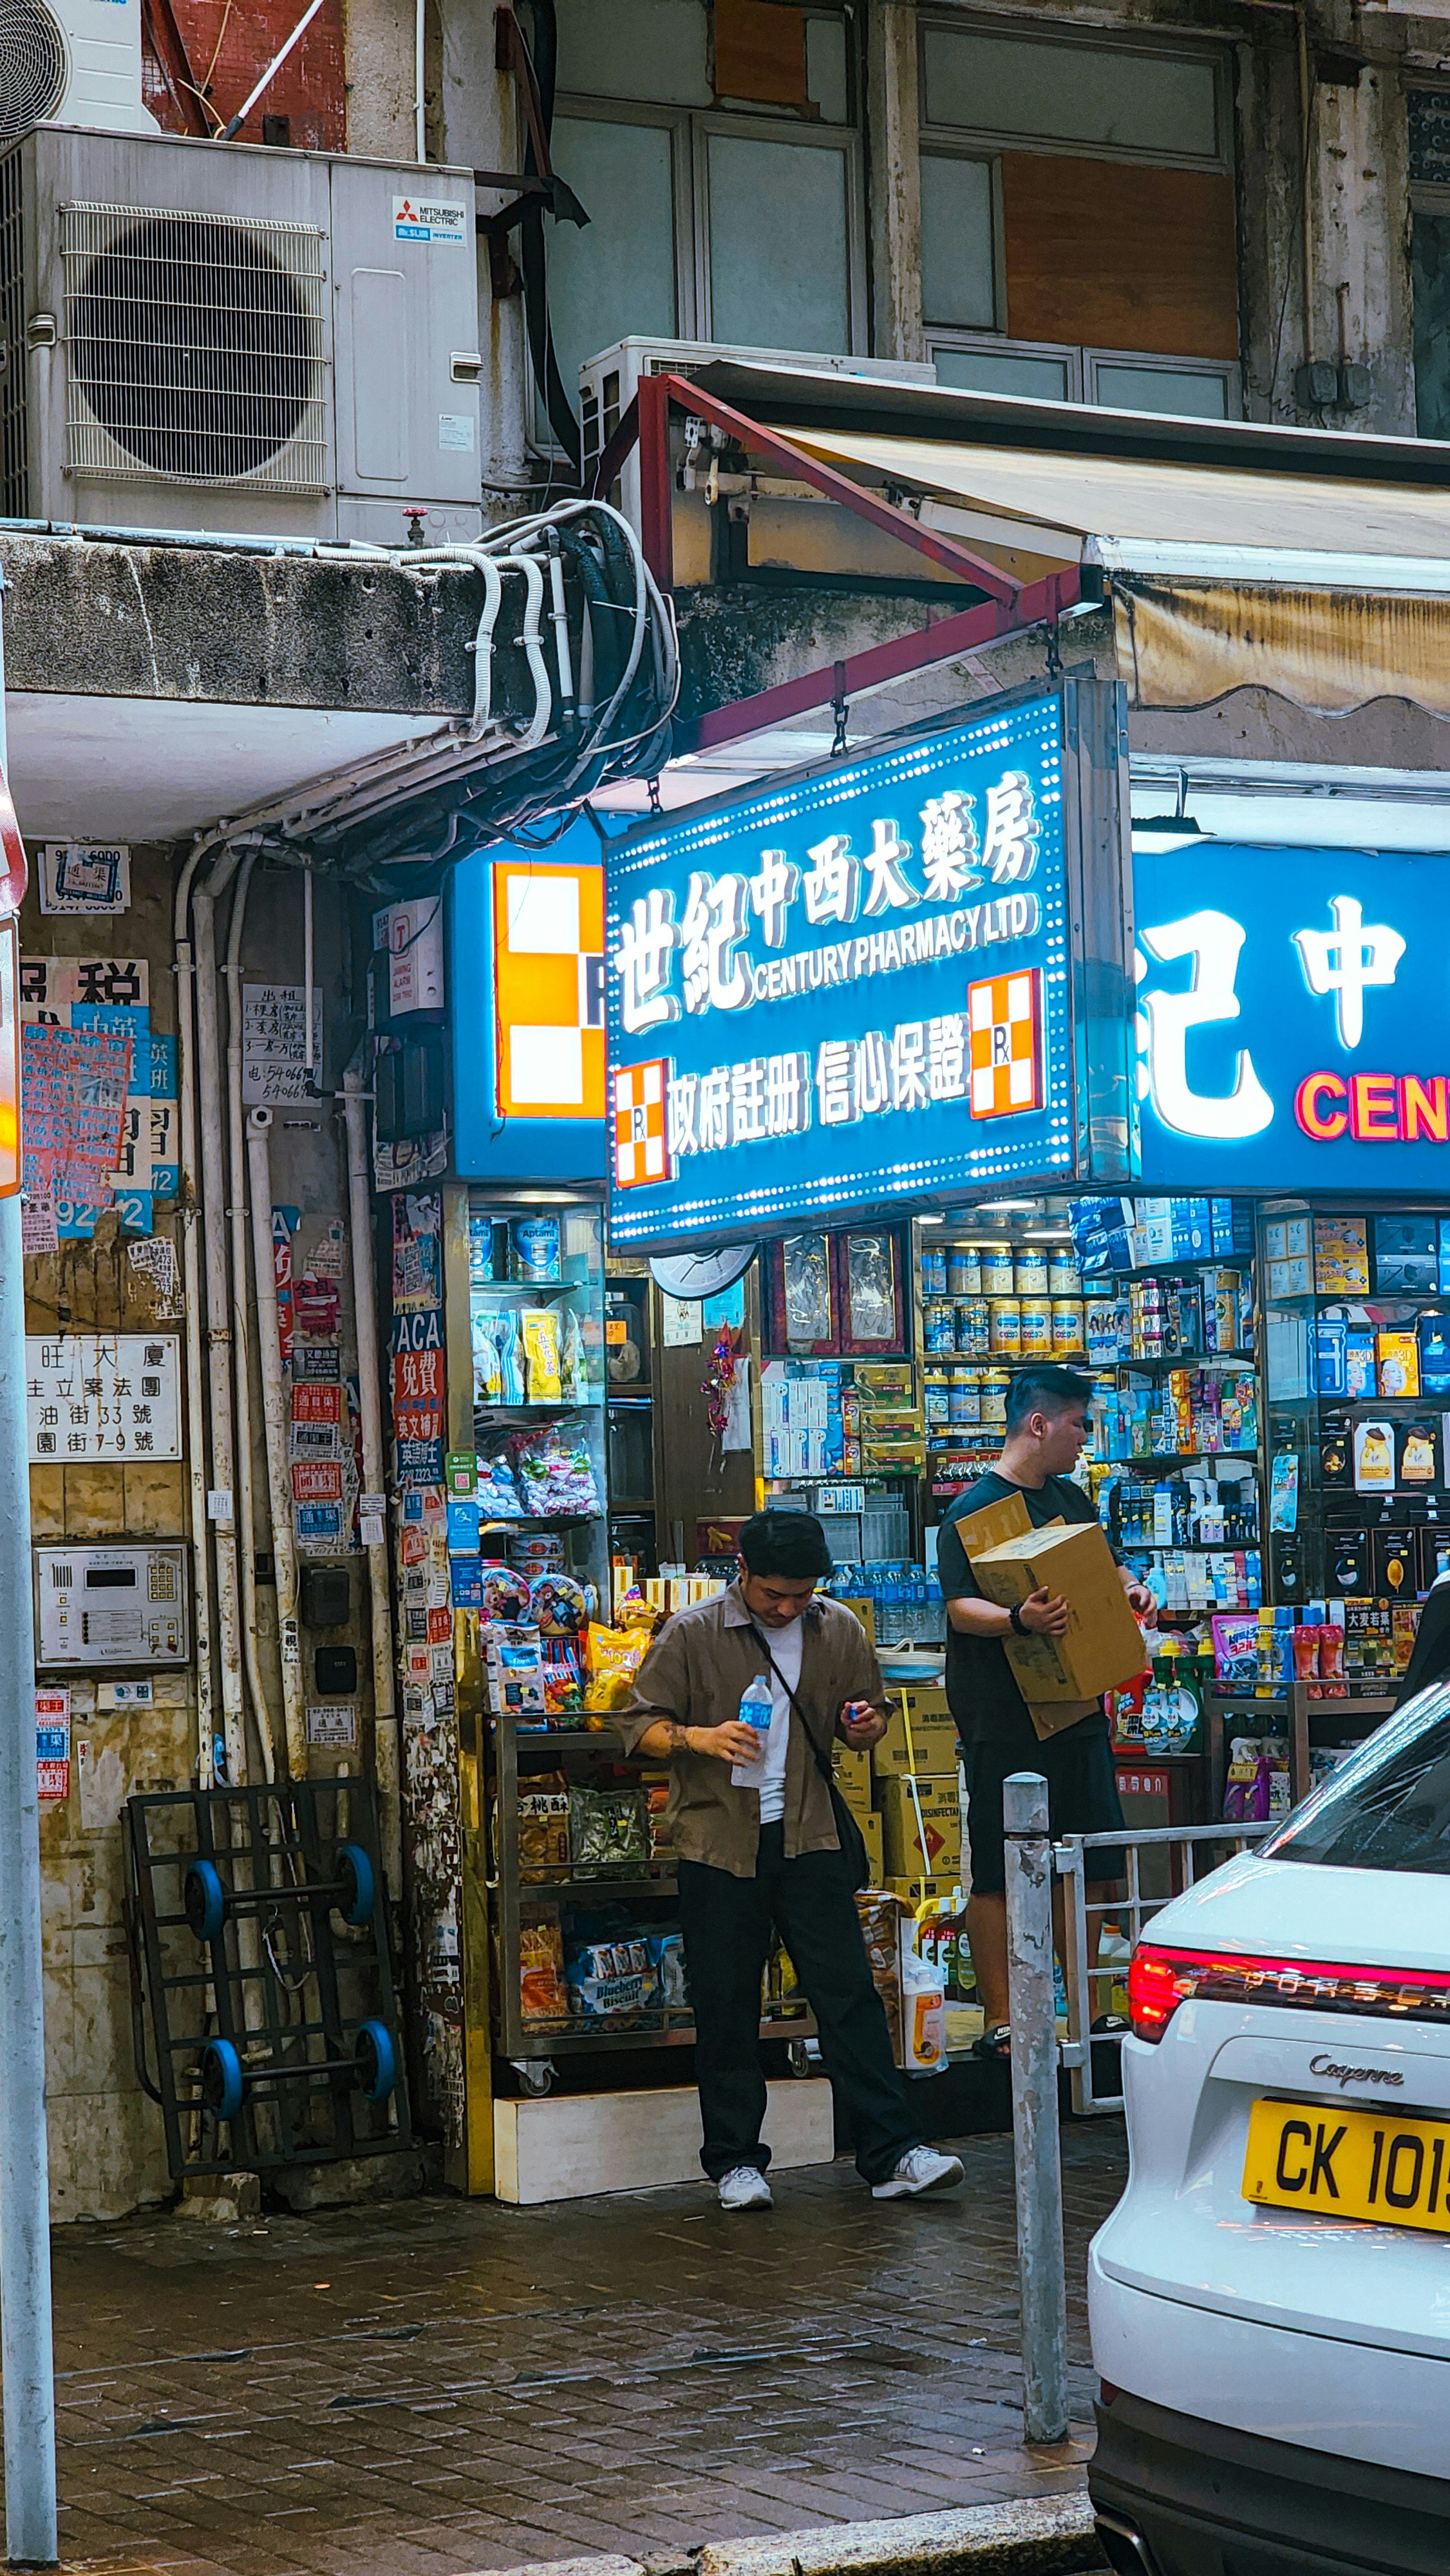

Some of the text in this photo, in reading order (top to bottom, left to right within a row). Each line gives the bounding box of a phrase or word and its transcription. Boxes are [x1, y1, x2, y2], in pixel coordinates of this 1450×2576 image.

[420, 206, 464, 219] MITSUBISHI
[420, 214, 458, 226] ELECTRIC
[433, 232, 463, 241] INVERTER
[614, 770, 1042, 1034] 世紀中西大藥房
[753, 893, 1035, 1001] CENTURY PHARMACY LTD
[667, 1012, 968, 1156] 政府註冊 信心保證
[1294, 1070, 1450, 1142] CEN
[397, 1312, 441, 1353] ACA
[400, 1350, 438, 1399] 免費
[596, 1977, 643, 2000] Blueberry
[602, 1989, 640, 2009] Biscuit
[1309, 2054, 1405, 2088] Cayenne
[1276, 2119, 1450, 2213] CK 101
